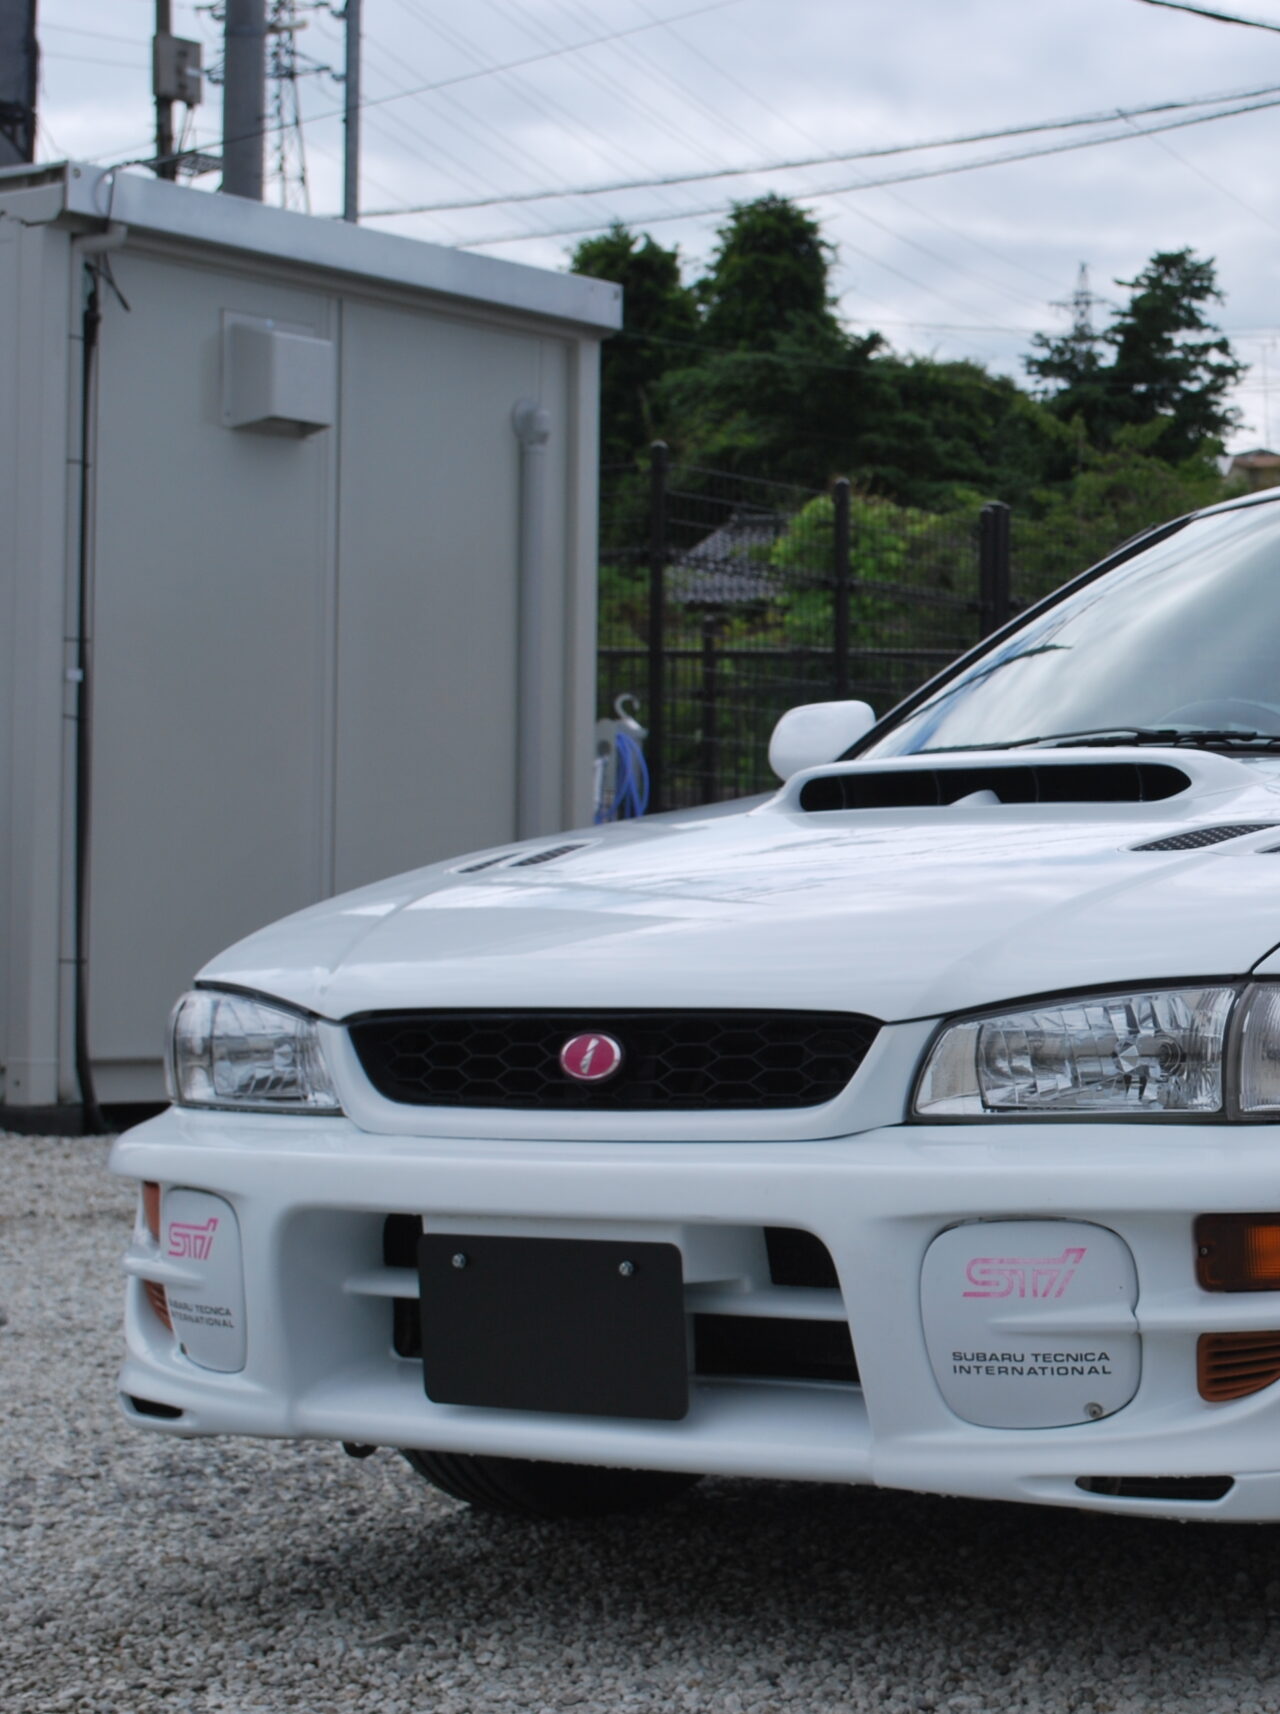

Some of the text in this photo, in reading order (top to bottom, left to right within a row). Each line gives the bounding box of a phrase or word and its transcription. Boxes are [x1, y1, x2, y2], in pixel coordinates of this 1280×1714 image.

[195, 1304, 232, 1316] TECNICA
[952, 1351, 1110, 1363] SUBARU TECNICA
[953, 1365, 1112, 1376] INTERNATIONAL
